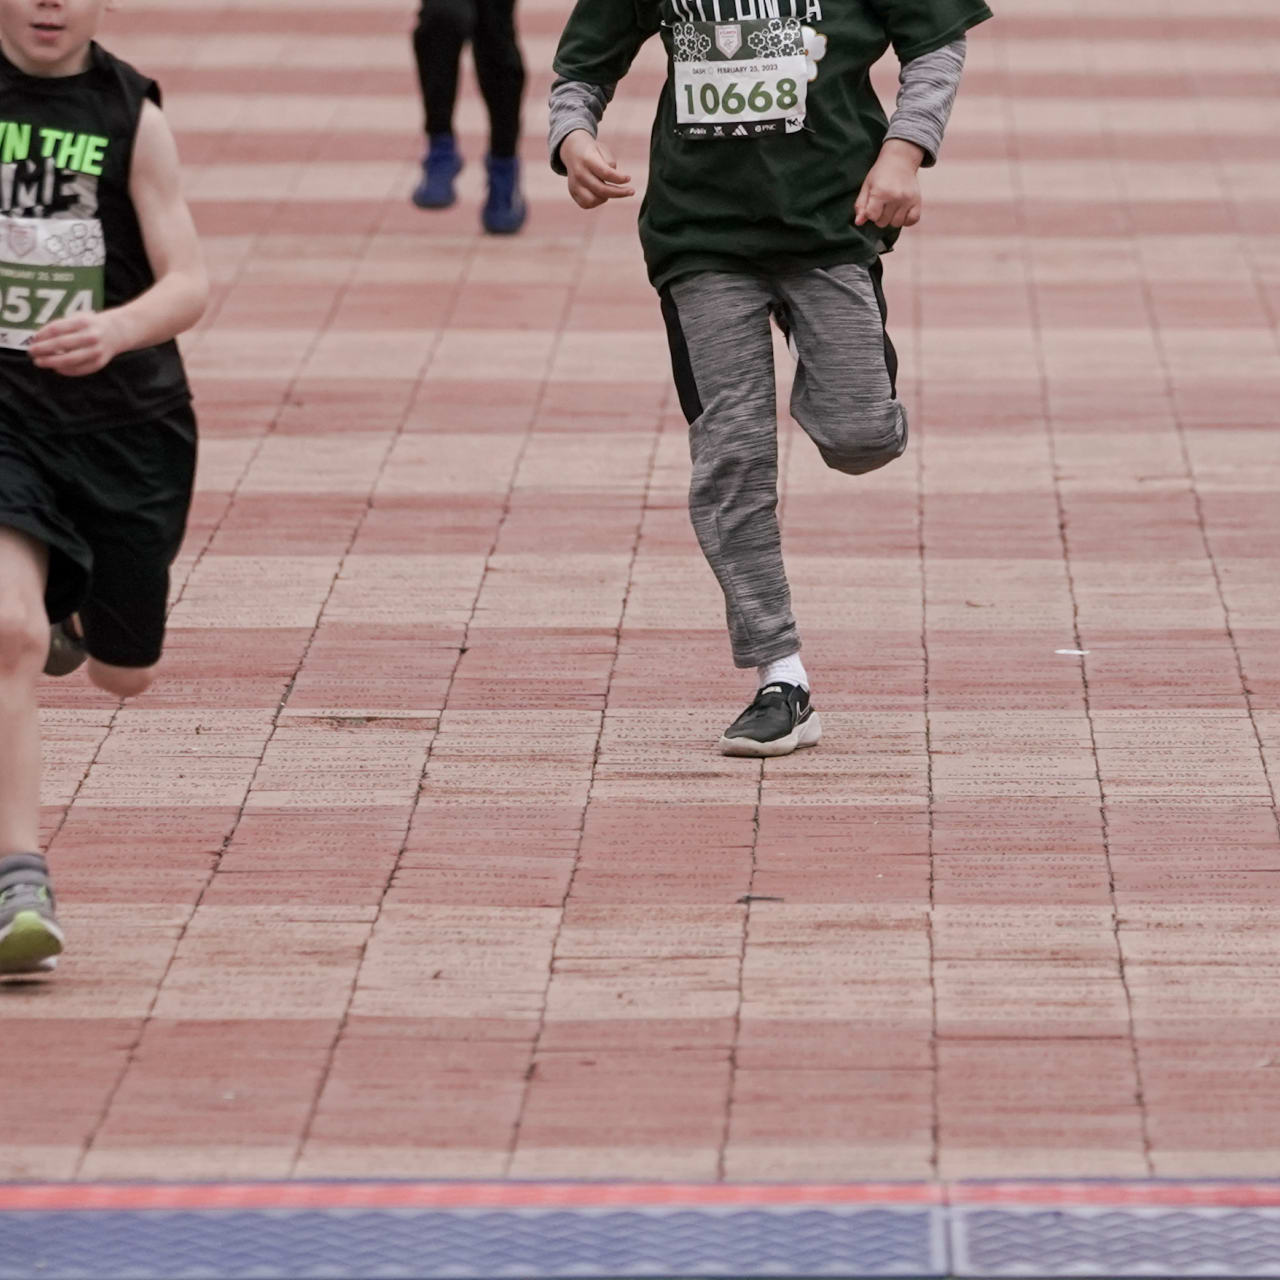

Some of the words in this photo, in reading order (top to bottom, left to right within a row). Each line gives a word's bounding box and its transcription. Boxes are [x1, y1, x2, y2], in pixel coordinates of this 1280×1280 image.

[717, 66, 748, 74] FEBRUARY
[684, 78, 798, 116] 10668
[39, 128, 109, 176] THE
